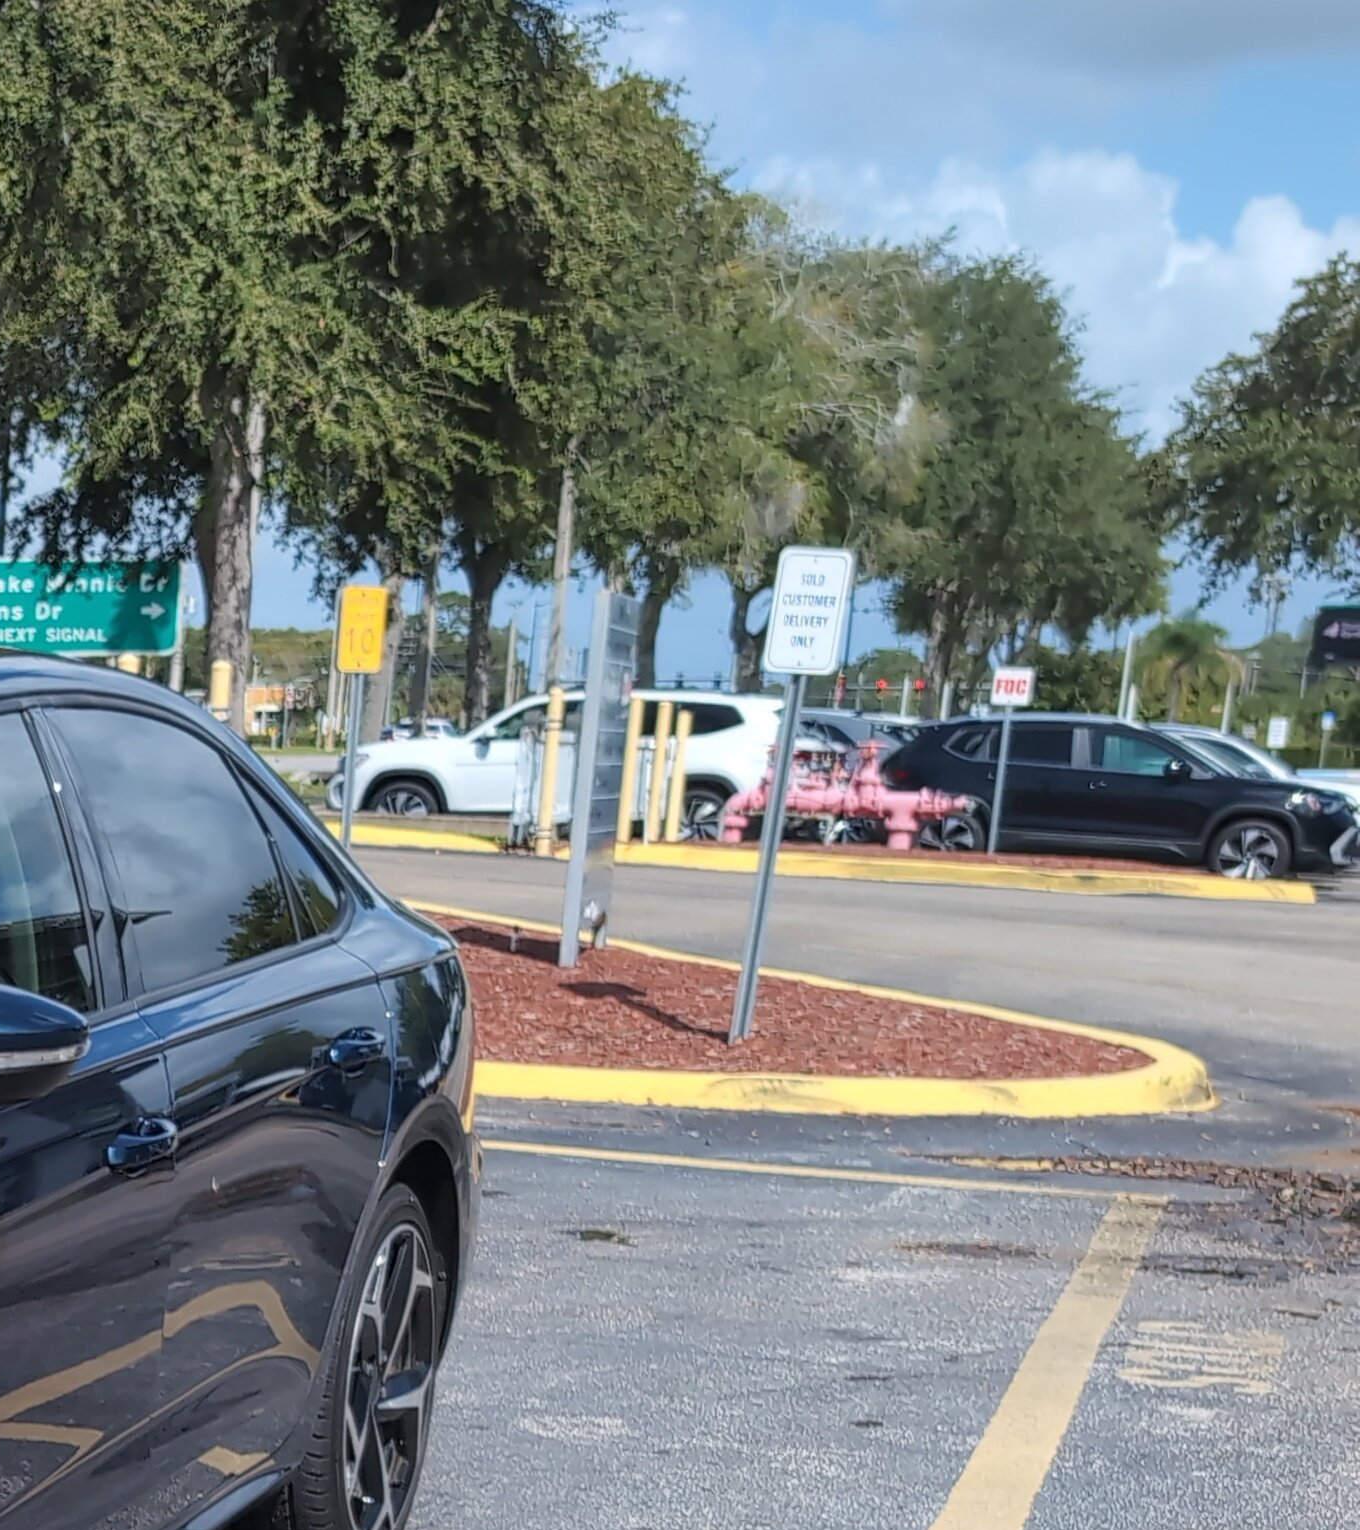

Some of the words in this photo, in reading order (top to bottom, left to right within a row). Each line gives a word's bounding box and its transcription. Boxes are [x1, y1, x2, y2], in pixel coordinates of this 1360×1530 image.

[139, 573, 169, 593] Dr
[800, 573, 825, 586] SOLD
[782, 594, 837, 608] CUSTOMER
[35, 602, 63, 621] Dr
[783, 614, 829, 628] DELIVERY
[45, 627, 108, 643] SIGNAL
[346, 627, 375, 655] 10
[790, 635, 814, 648] ONLY
